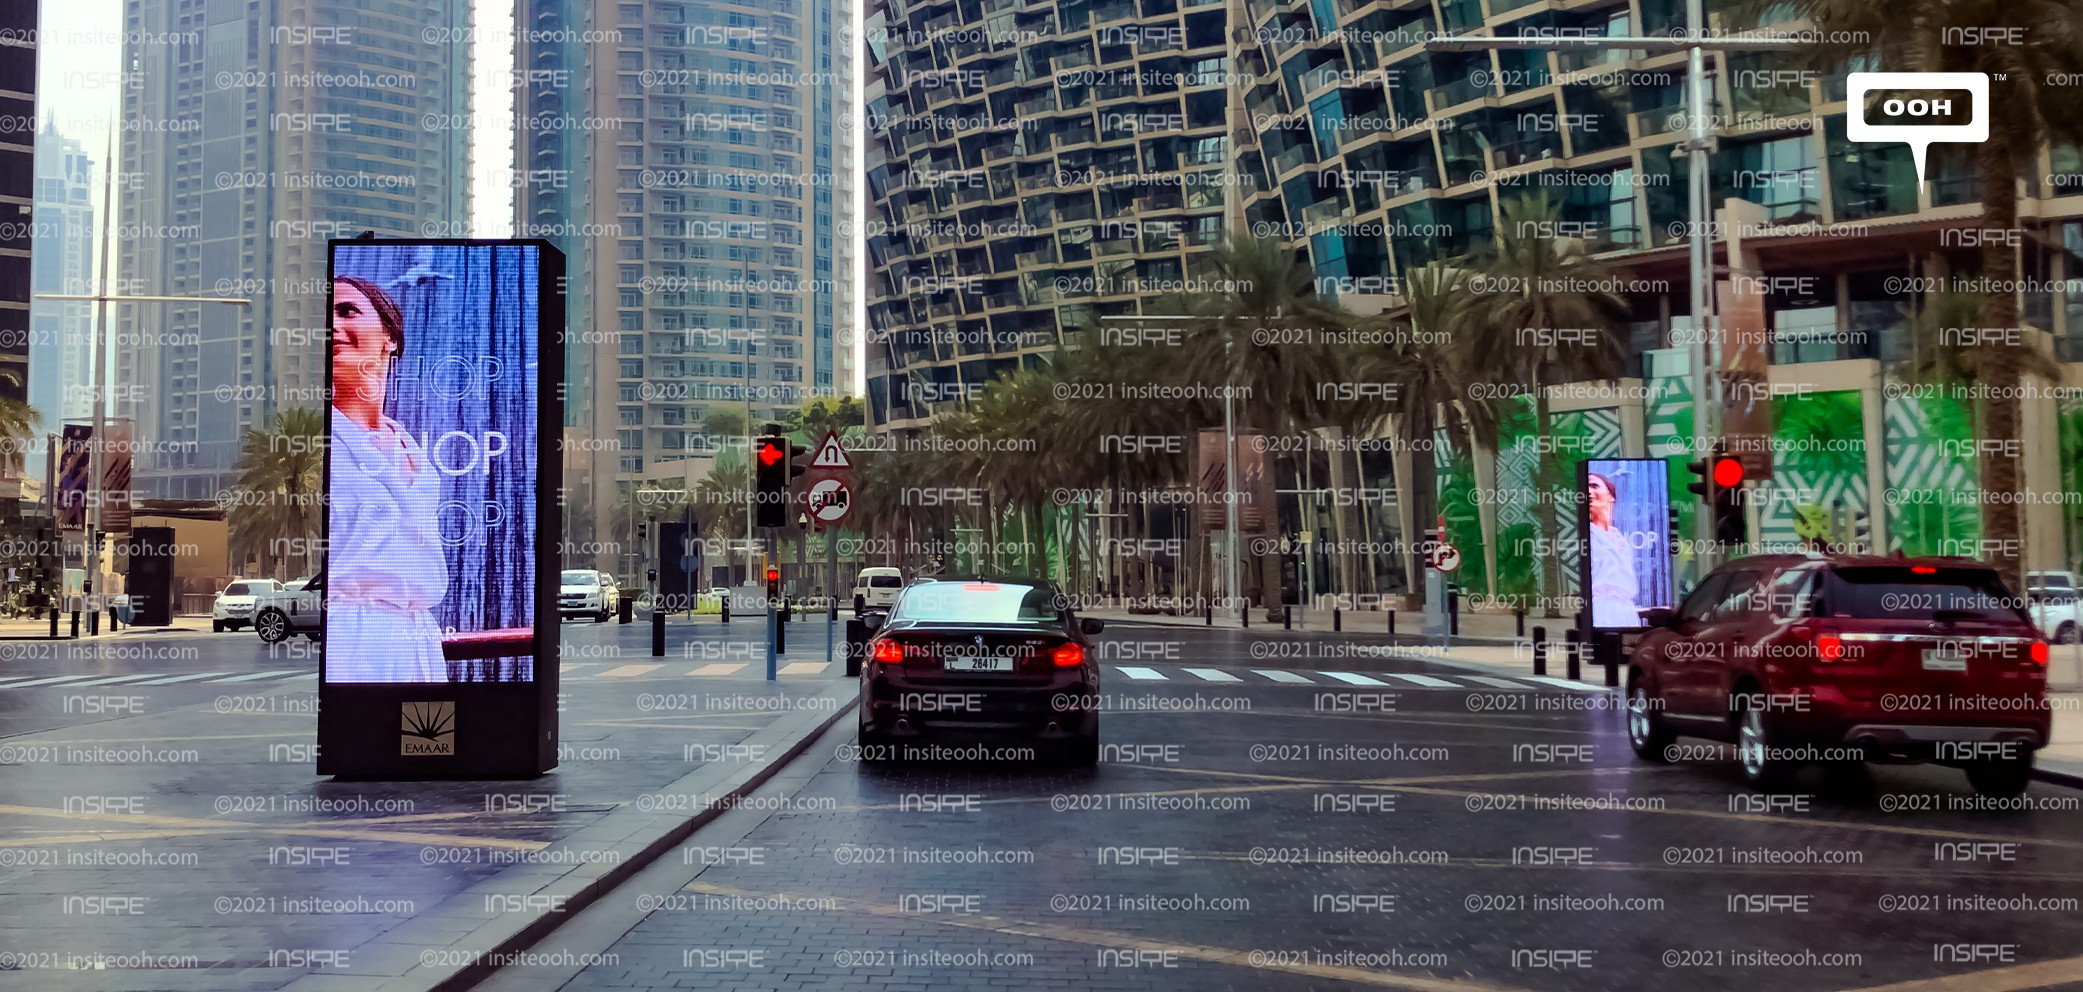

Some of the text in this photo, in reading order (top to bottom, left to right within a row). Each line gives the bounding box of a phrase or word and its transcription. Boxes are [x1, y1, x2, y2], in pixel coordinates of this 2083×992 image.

[355, 355, 505, 401] SHOP
[972, 657, 999, 669] 26417
[405, 743, 451, 754] EMAAR
